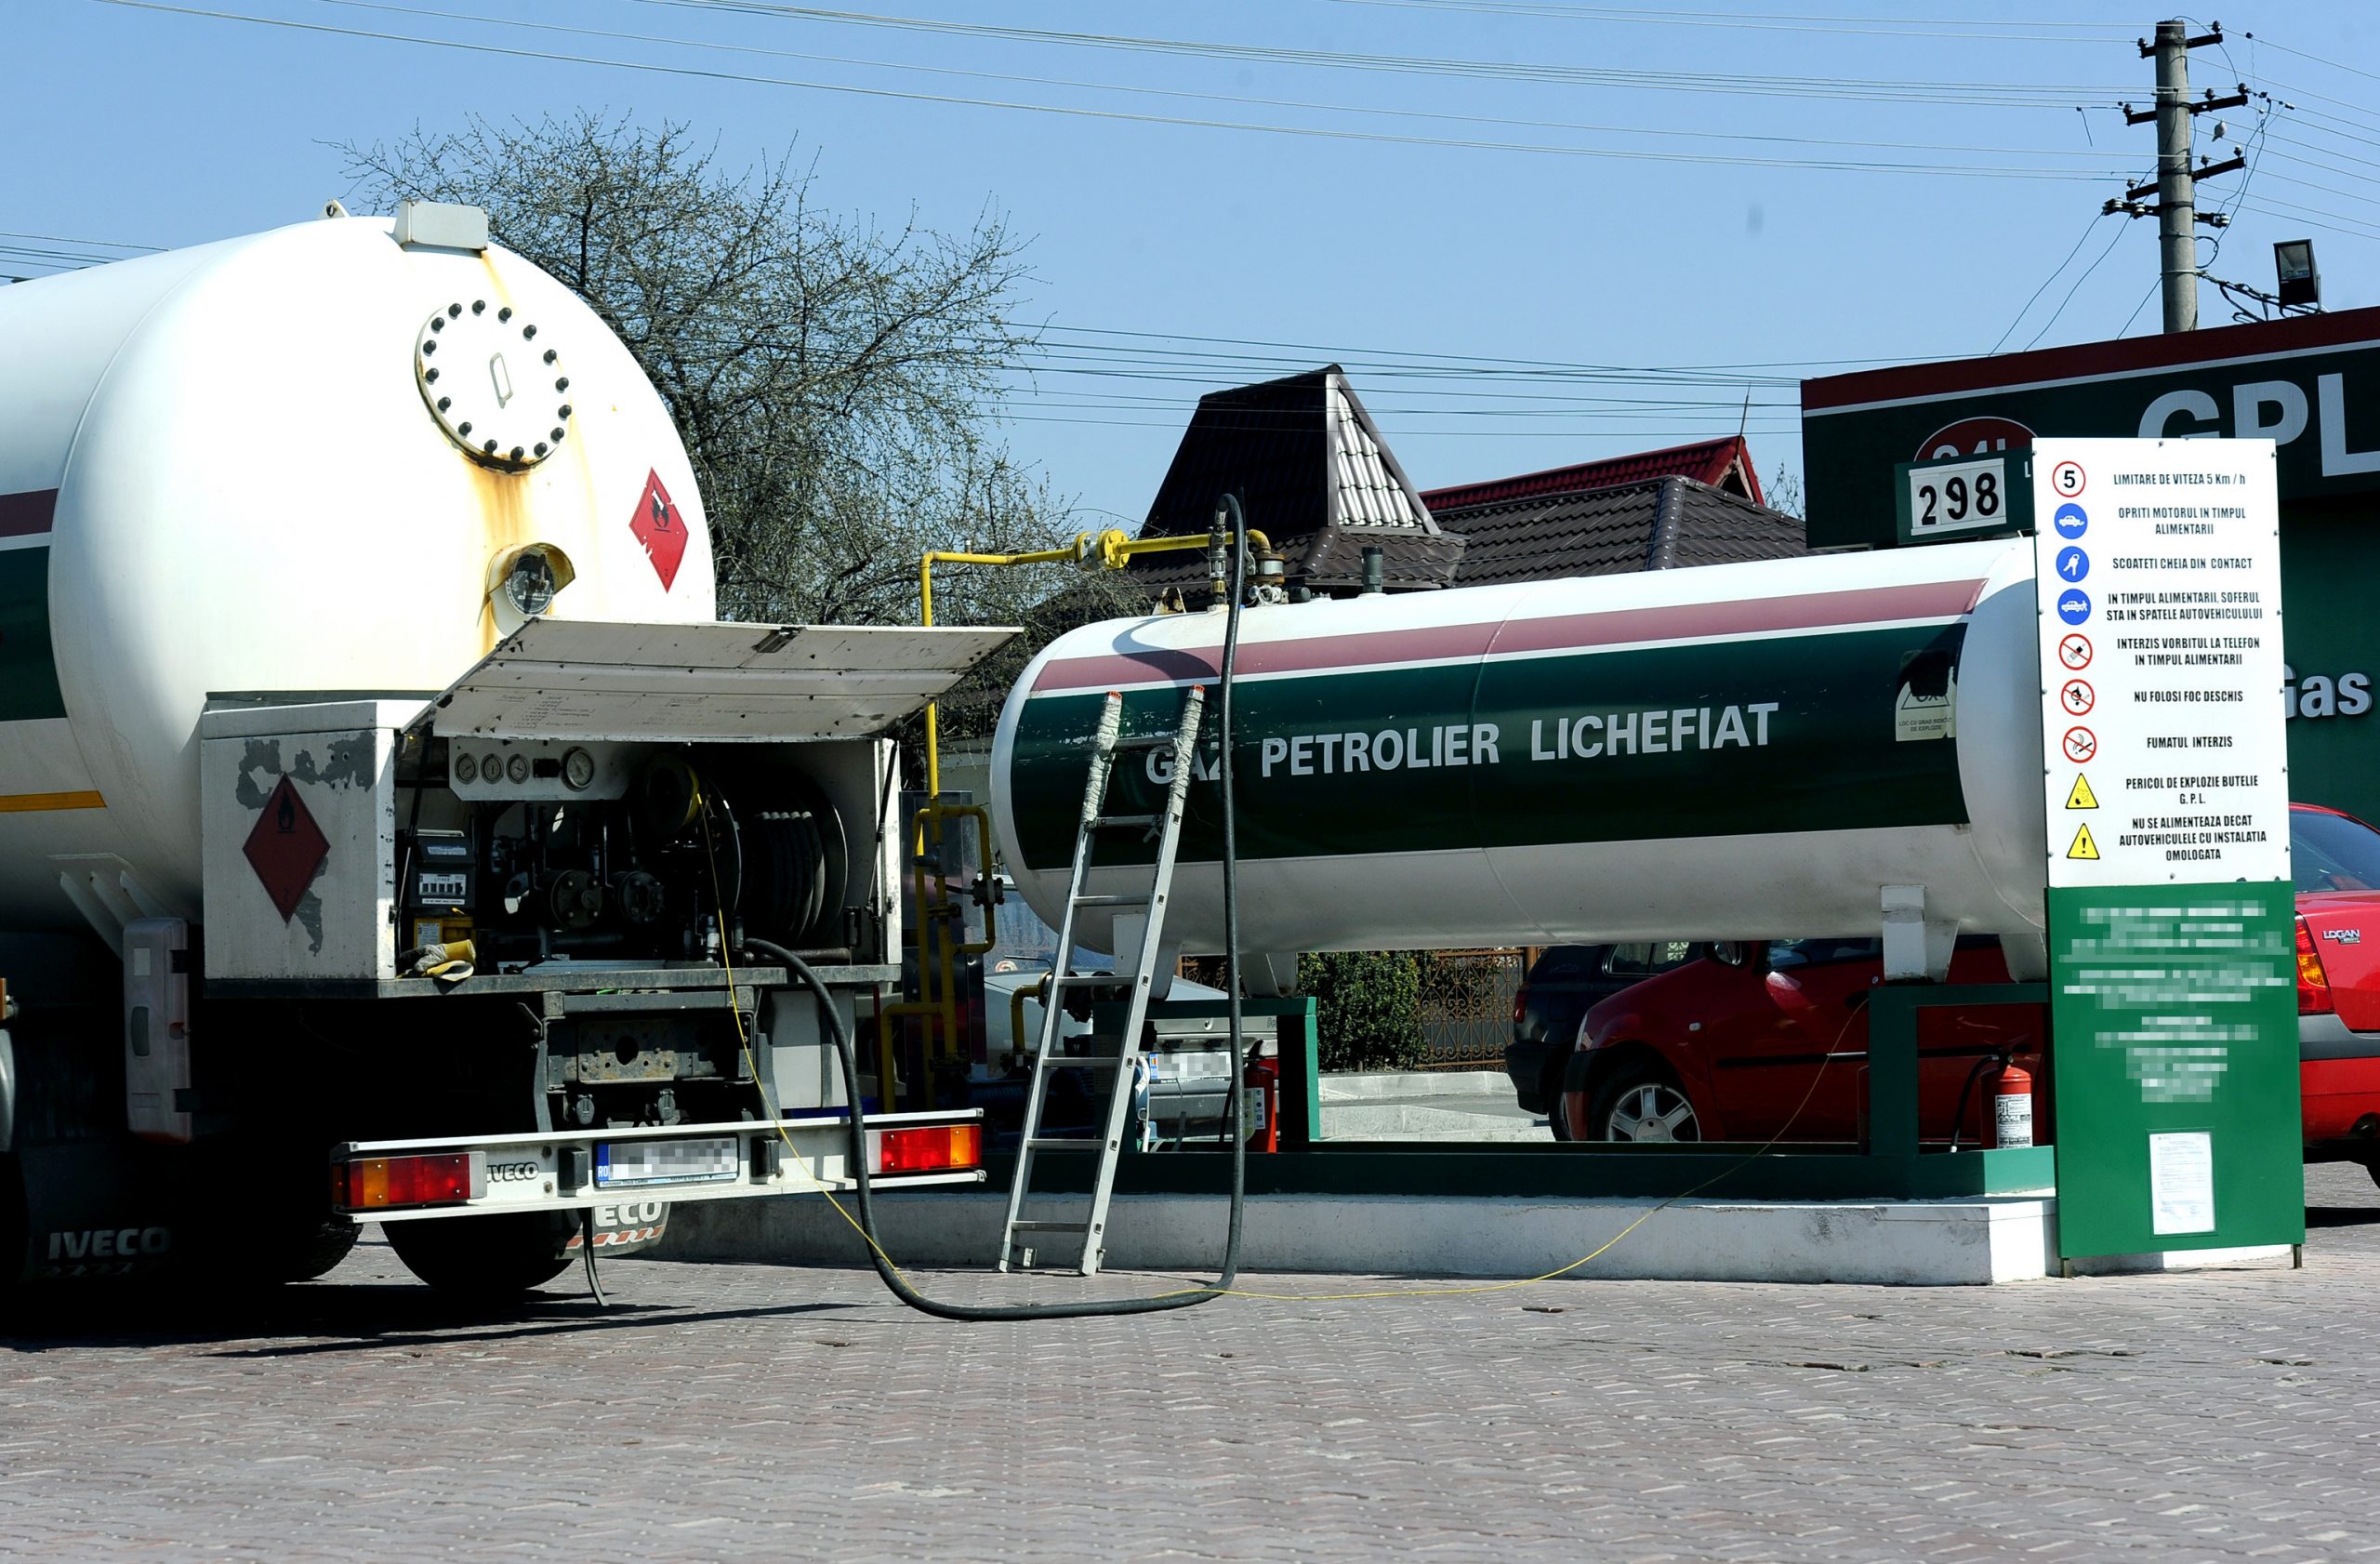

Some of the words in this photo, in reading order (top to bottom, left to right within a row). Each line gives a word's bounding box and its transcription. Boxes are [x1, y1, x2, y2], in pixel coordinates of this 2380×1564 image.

[2063, 470, 2076, 489] 5
[2113, 474, 2157, 485] LIMITARE
[2159, 473, 2171, 484] DE
[2173, 473, 2204, 484] VITEZA
[2207, 473, 2213, 484] 5
[2215, 474, 2230, 484] Km
[2240, 474, 2245, 484] h
[1918, 471, 1999, 526] 298
[2119, 508, 2150, 519] OPRITI
[2152, 507, 2198, 518] MOTORUL
[2200, 508, 2209, 518] IN
[2212, 508, 2246, 519] TIMPUL
[2155, 524, 2214, 535] ALIMENTARII
[2112, 558, 2158, 569] SCOATETI
[2160, 558, 2188, 569] CHEIA
[2190, 558, 2206, 569] DIN
[2211, 558, 2252, 569] CONTACT
[2108, 593, 2118, 604] IN
[2121, 592, 2156, 604] TIMPUL
[2159, 592, 2218, 603] ALIMENTARII,
[2221, 591, 2260, 603] SOFERUL
[2107, 610, 2125, 621] STA
[2127, 609, 2136, 620] IN
[2139, 609, 2177, 620] SPATELE
[2179, 608, 2262, 620] AUTOVEHICULULUI
[2117, 638, 2160, 649] INTERZIS
[2162, 638, 2208, 649] VORBITUL
[2210, 637, 2221, 648] LA
[2223, 637, 2260, 648] TELEFON
[2135, 655, 2145, 666] IN
[2147, 654, 2183, 666] TIMPUL
[2185, 654, 2242, 665] ALIMENTARII
[2134, 691, 2148, 702] NU
[2149, 691, 2181, 702] FOLOSI
[2184, 691, 2202, 702] FOC
[2203, 691, 2243, 702] DESCHIS
[1262, 722, 1501, 777] PETROLIER
[1531, 702, 1779, 762] LICHEFIAT
[2147, 736, 2188, 749] FUMATUL
[2192, 736, 2233, 748] INTERZIS
[2126, 777, 2164, 789] PERICOL
[2166, 776, 2177, 789] DE
[2180, 775, 2220, 789] EXPLOZIE
[2222, 775, 2258, 787] BUTELIE
[2132, 818, 2145, 829] NU
[2147, 817, 2159, 829] SE
[2161, 815, 2222, 828] ALIMENTEAZA
[2224, 815, 2253, 827] DECAT
[2119, 832, 2197, 846] AUTOVEHICULELE
[2199, 832, 2212, 844] CU
[2214, 830, 2267, 843] INSTALATIA
[2166, 848, 2221, 861] OMOLOGATA
[2322, 929, 2360, 940] LOGAN
[597, 1165, 609, 1178] RO
[48, 1226, 171, 1260] IVECO
